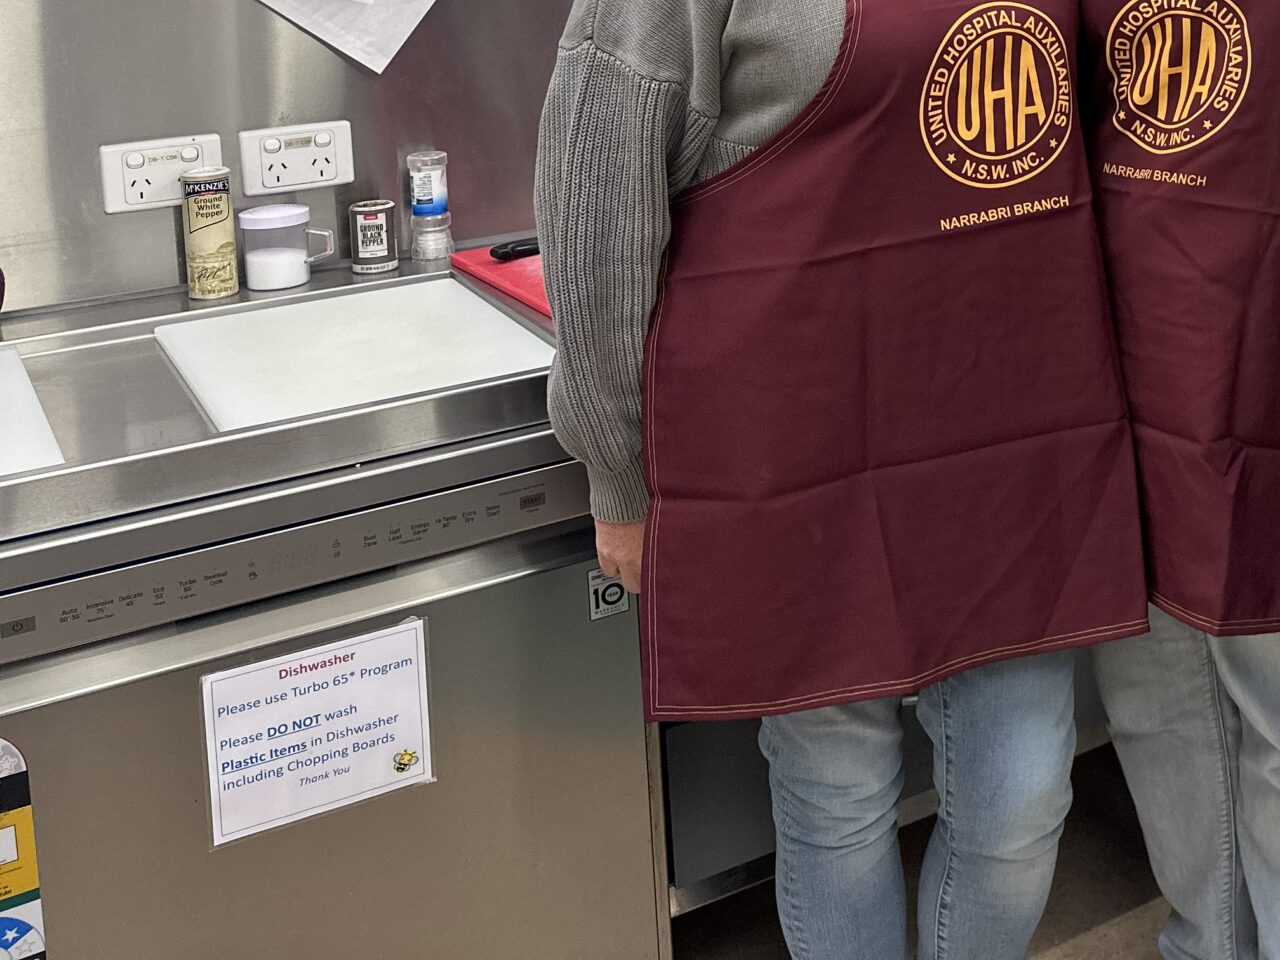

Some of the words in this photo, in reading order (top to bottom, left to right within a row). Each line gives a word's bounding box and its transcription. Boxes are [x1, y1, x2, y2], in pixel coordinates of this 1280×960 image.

[1116, 38, 1132, 100] UNITED
[1204, 0, 1245, 113] AUXILIARIES
[1132, 17, 1217, 122] UHA
[928, 67, 948, 146] UNITED
[945, 9, 1022, 65] HOSPITAL
[1023, 16, 1070, 128] AUXILIARIES
[957, 35, 1046, 153] UHA
[1169, 128, 1196, 146] INC.
[962, 158, 1009, 180] N.S.W.
[1012, 152, 1044, 176] INC.
[1153, 170, 1207, 187] BRANCH
[194, 196, 222, 205] Ground
[196, 210, 223, 219] Pepper
[940, 206, 1011, 231] NARRABRI
[1014, 195, 1070, 216] BRANCH
[360, 224, 383, 232] GROUND
[362, 238, 383, 246] PEPPER
[593, 582, 625, 610] 10
[278, 651, 356, 680] Dishwasher
[218, 700, 261, 718] Please
[265, 691, 288, 705] use
[291, 680, 329, 698] Turbo
[360, 657, 413, 679] Program
[220, 731, 263, 751] Please
[267, 724, 288, 738] DO
[292, 714, 321, 731] NOT
[324, 704, 358, 721] wash
[222, 753, 266, 772] Plastic
[270, 741, 307, 759] Items
[310, 736, 322, 747] in
[326, 713, 399, 742] Dishwasher
[222, 767, 284, 792] including
[287, 746, 349, 772] Chopping
[352, 732, 396, 753] Boards
[299, 770, 330, 787] Thank
[332, 766, 350, 778] You
